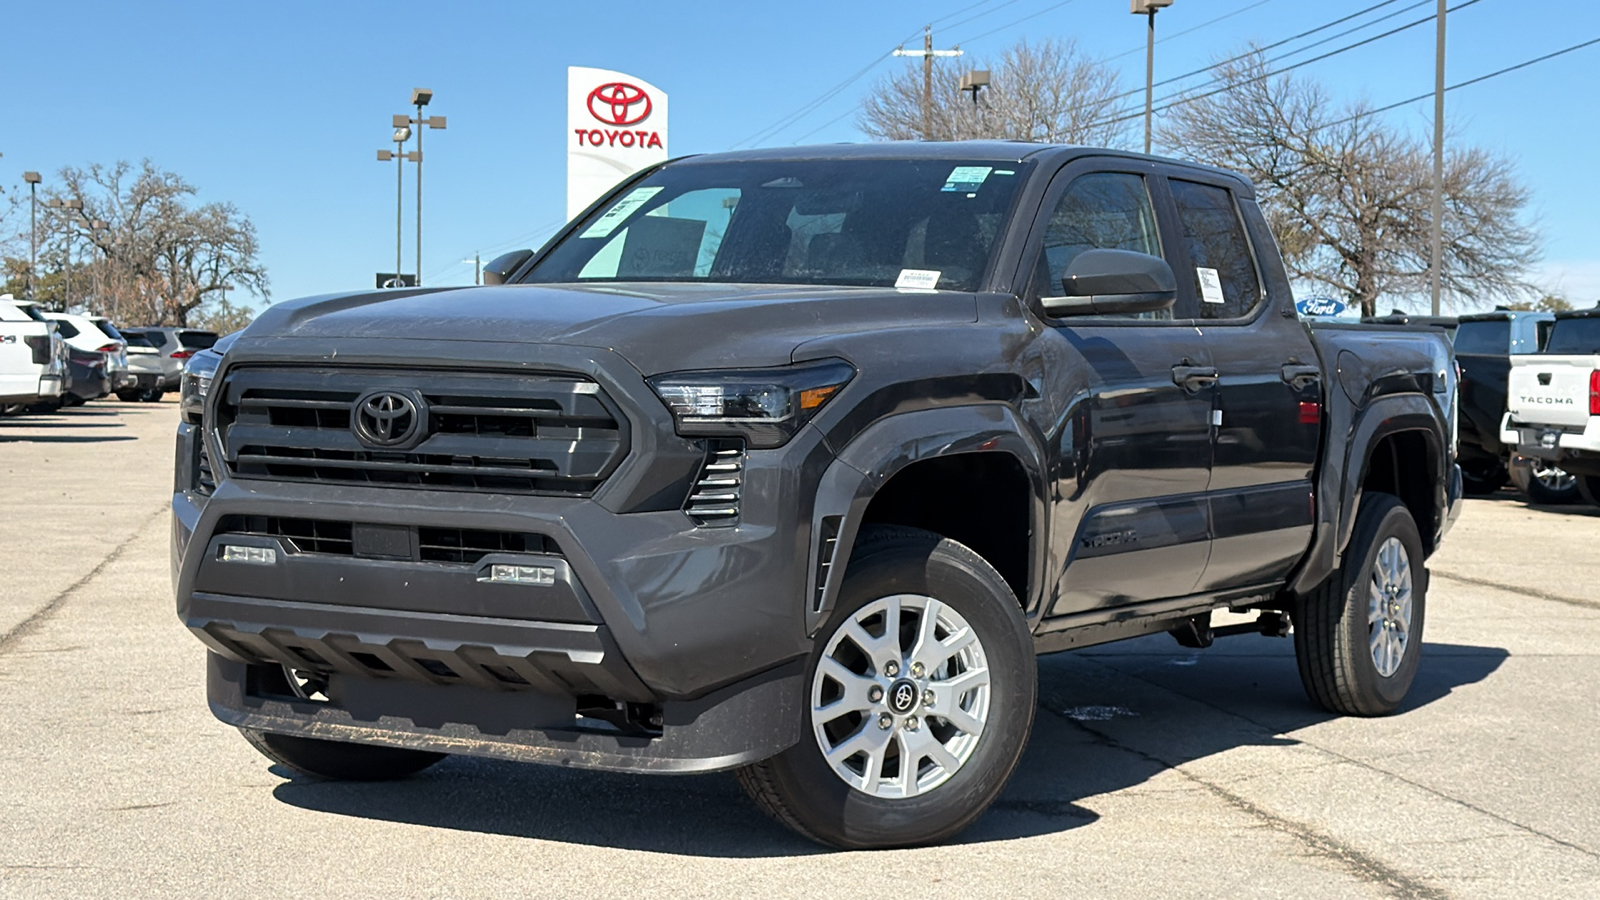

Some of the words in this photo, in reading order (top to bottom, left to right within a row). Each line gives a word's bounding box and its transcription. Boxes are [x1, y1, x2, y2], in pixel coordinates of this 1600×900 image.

[575, 129, 662, 149] TOYOTA
[1302, 299, 1336, 315] Ford
[1520, 396, 1573, 405] TACOMA
